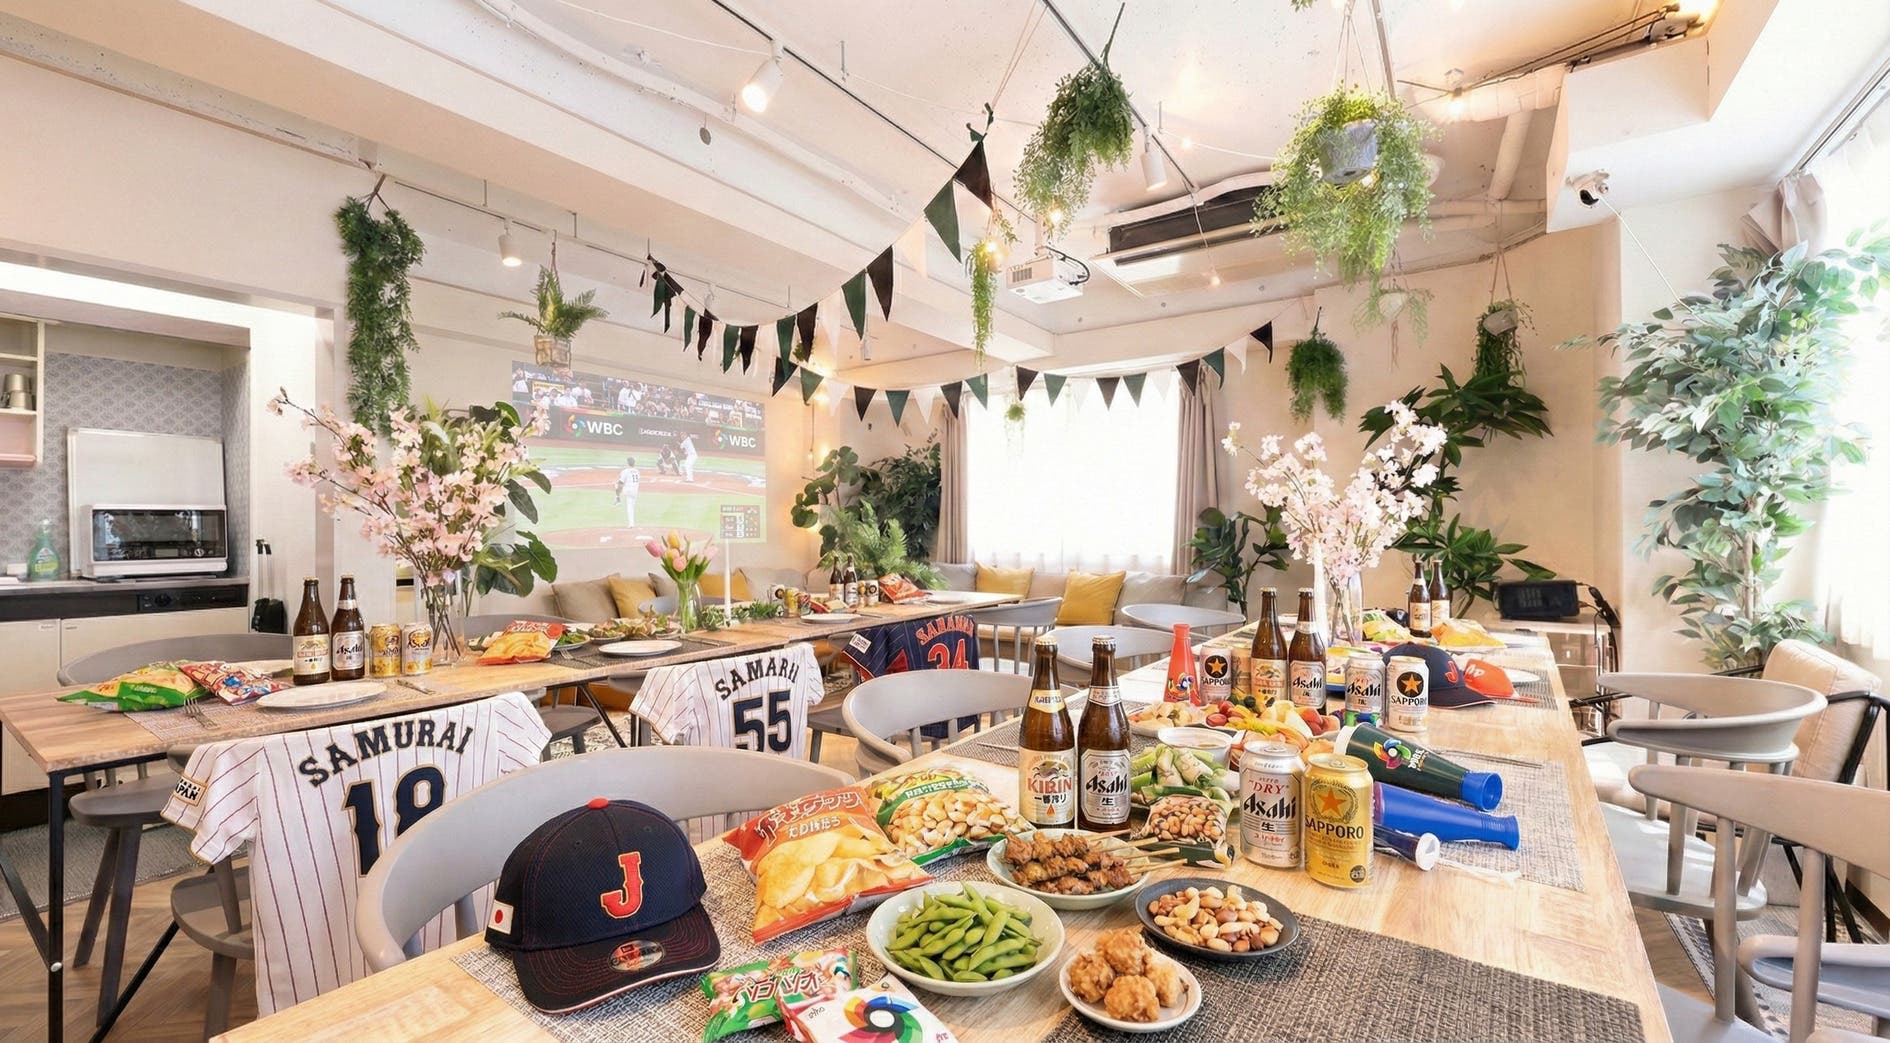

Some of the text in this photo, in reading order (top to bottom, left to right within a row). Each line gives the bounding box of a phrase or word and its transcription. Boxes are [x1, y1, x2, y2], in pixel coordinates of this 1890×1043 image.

[586, 421, 624, 436] WBC
[729, 434, 757, 448] WBC
[1445, 660, 1459, 684] J
[1293, 676, 1323, 689] Asahi
[1347, 682, 1381, 697] Asahi
[732, 689, 792, 753] 55
[297, 719, 474, 788] SAMURAI
[1027, 777, 1072, 794] KIRIN
[1086, 774, 1128, 794] Asahi
[1101, 797, 1114, 806] 生
[1243, 793, 1297, 820] Asahi
[1260, 821, 1275, 833] 生
[1305, 814, 1364, 840] SAPPORO
[600, 851, 645, 919] J
